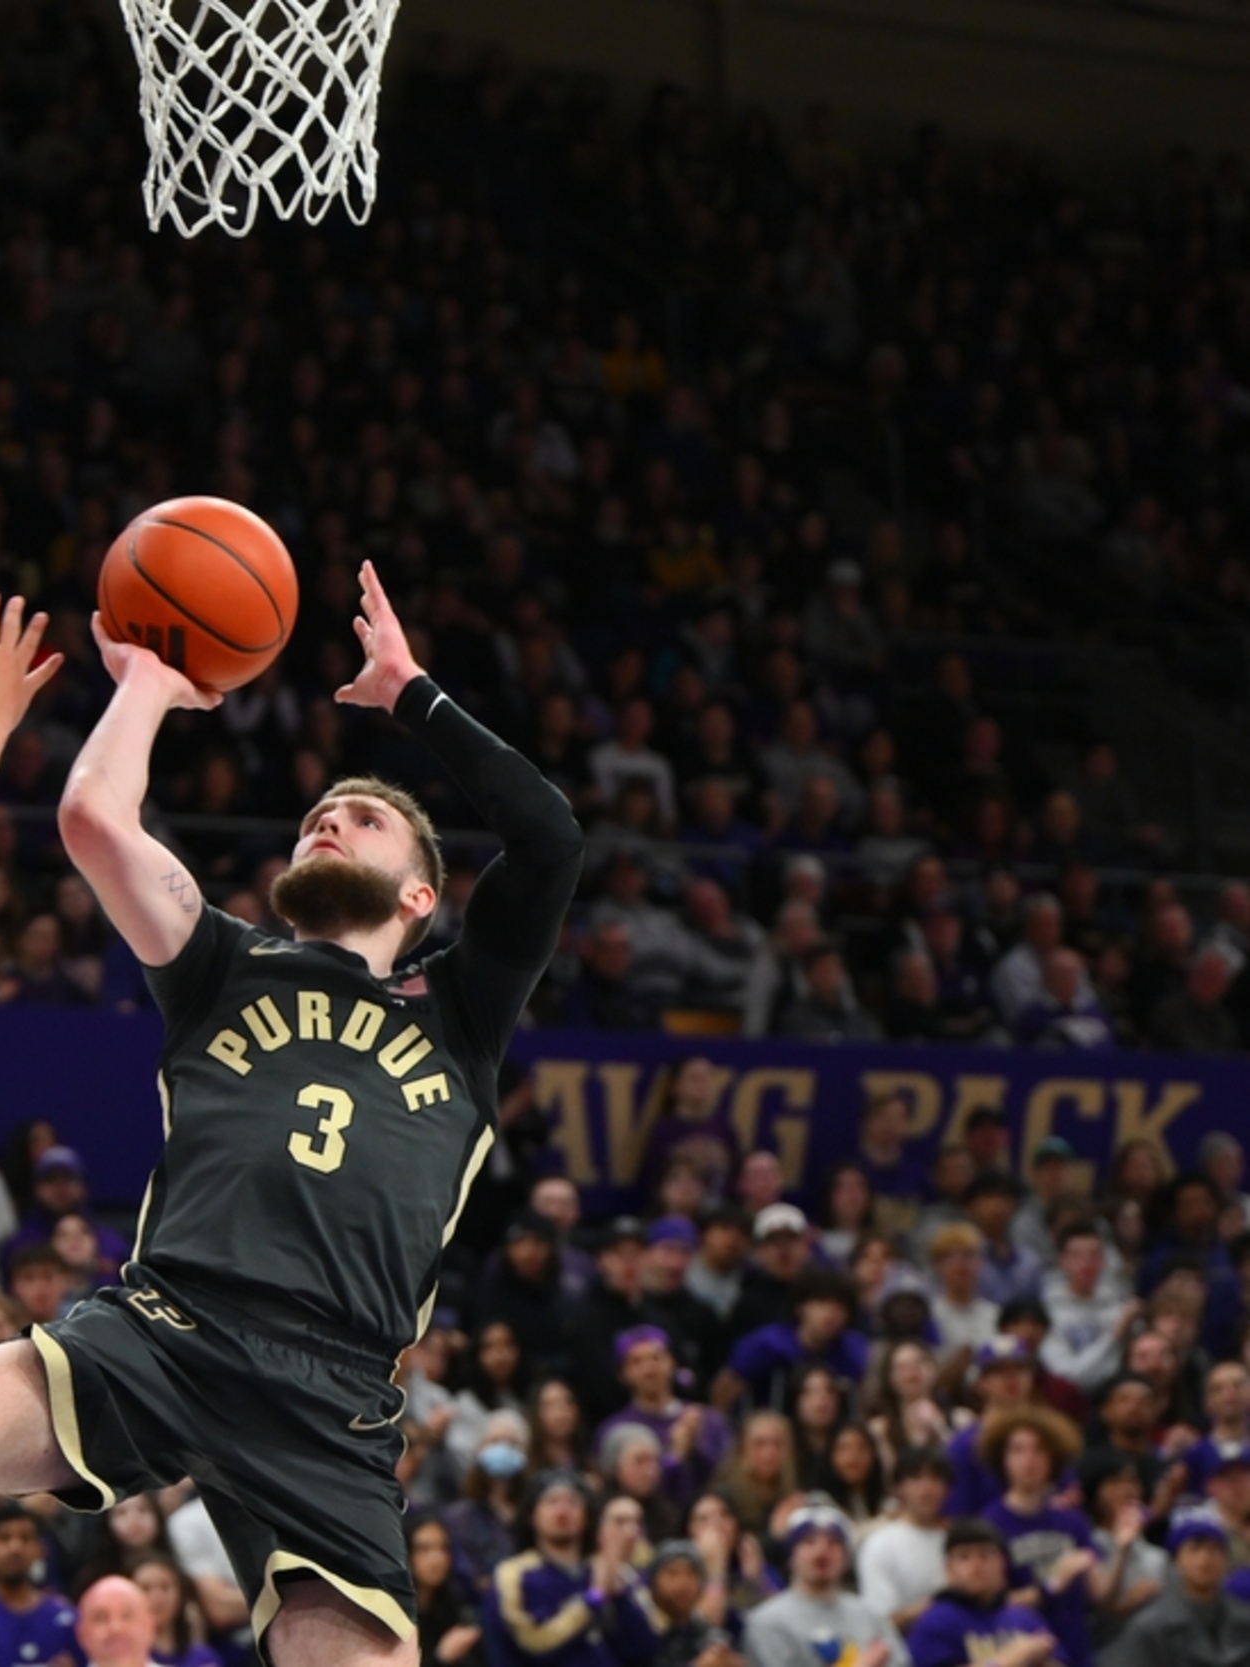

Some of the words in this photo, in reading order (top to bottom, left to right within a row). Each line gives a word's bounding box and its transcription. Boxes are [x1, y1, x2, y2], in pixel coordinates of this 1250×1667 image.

[205, 990, 451, 1114] PURDUE
[287, 1081, 355, 1175] 3
[859, 1068, 1203, 1200] PACK
